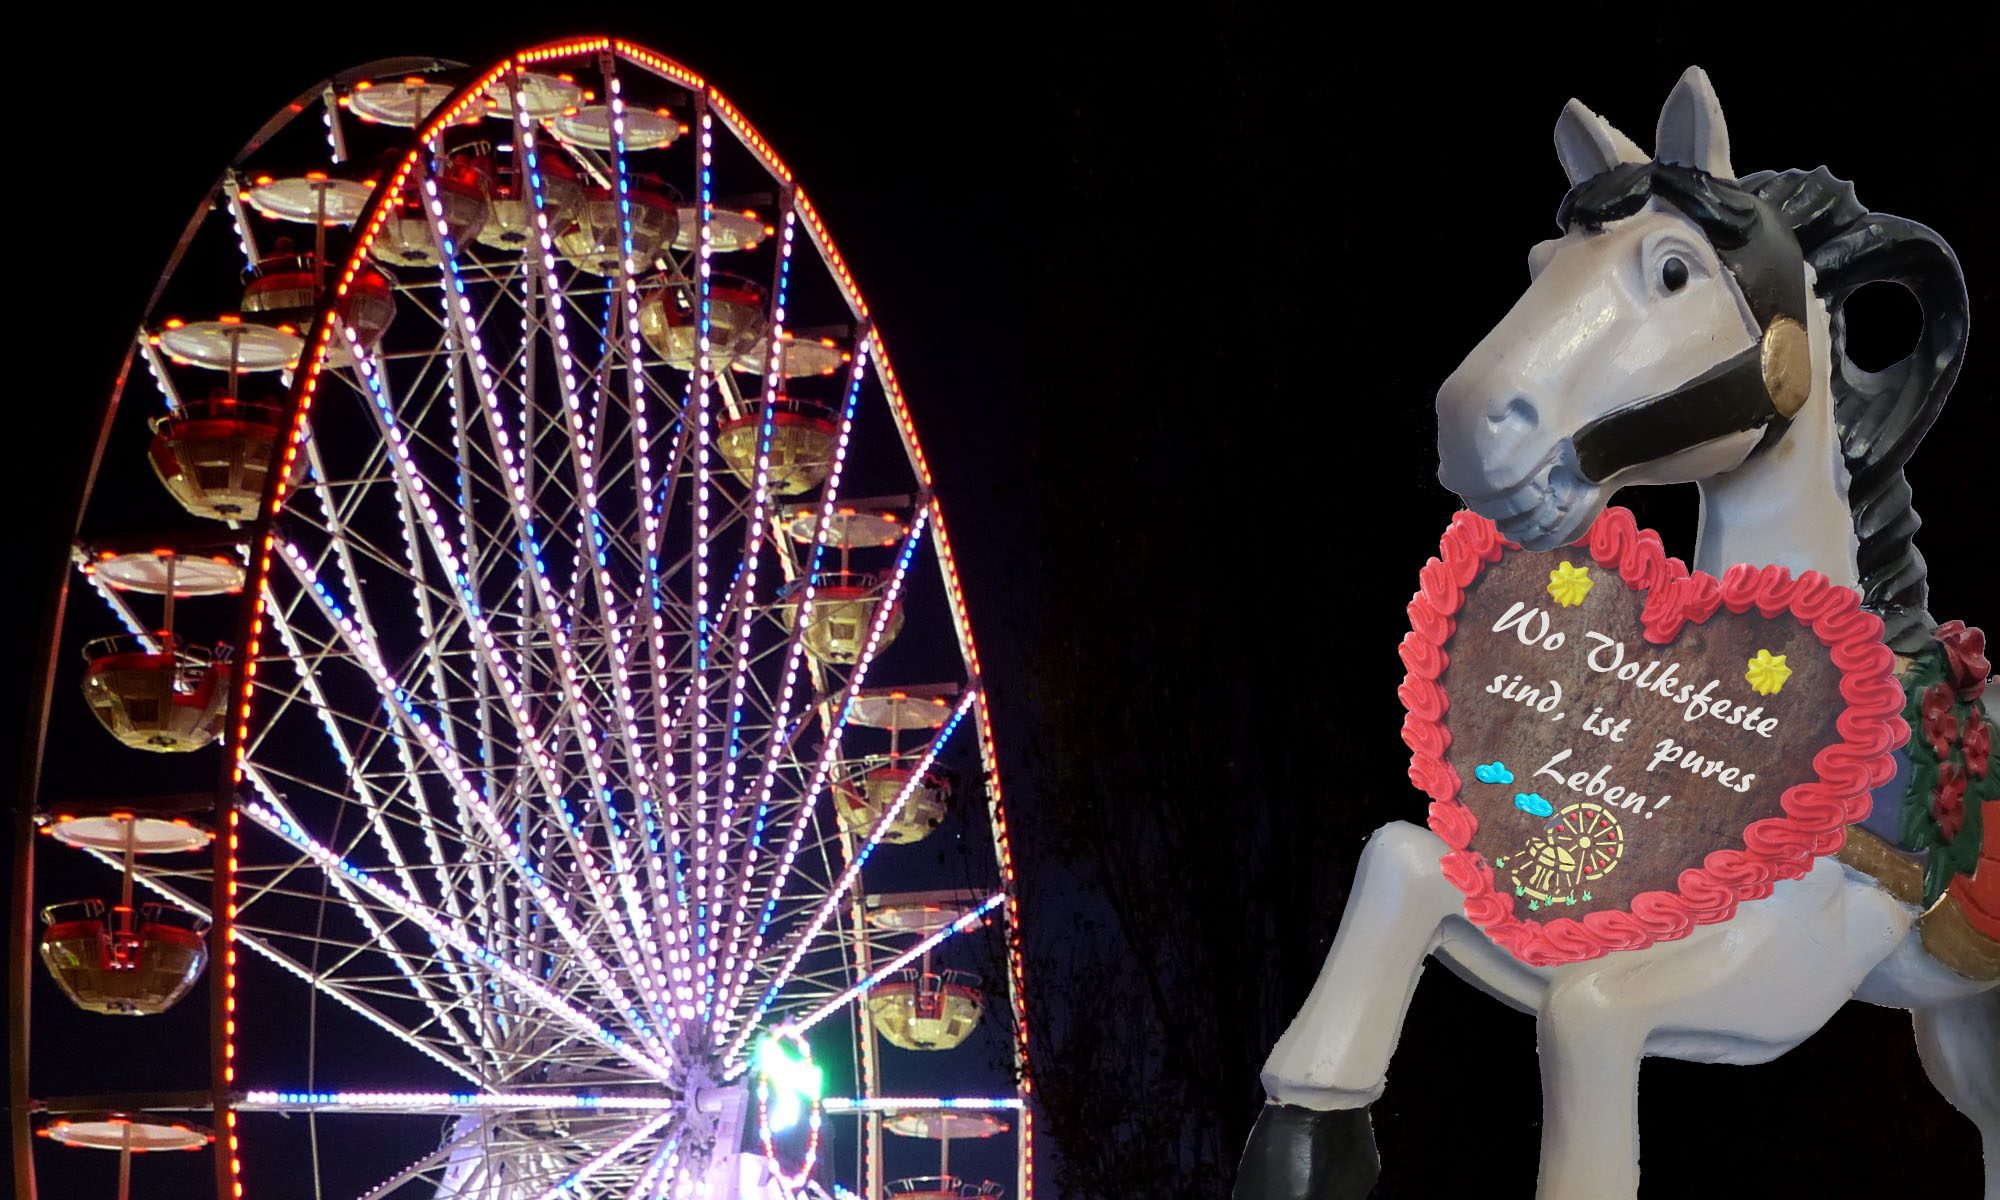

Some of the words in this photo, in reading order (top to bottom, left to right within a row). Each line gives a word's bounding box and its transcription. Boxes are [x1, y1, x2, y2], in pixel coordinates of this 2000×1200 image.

[1491, 601, 1567, 651] Wo
[1584, 630, 1779, 738] Volksfeste
[1485, 673, 1566, 722] sind,
[1582, 706, 1632, 743] ist
[1645, 738, 1756, 793] pures
[1532, 748, 1672, 820] Leben!
